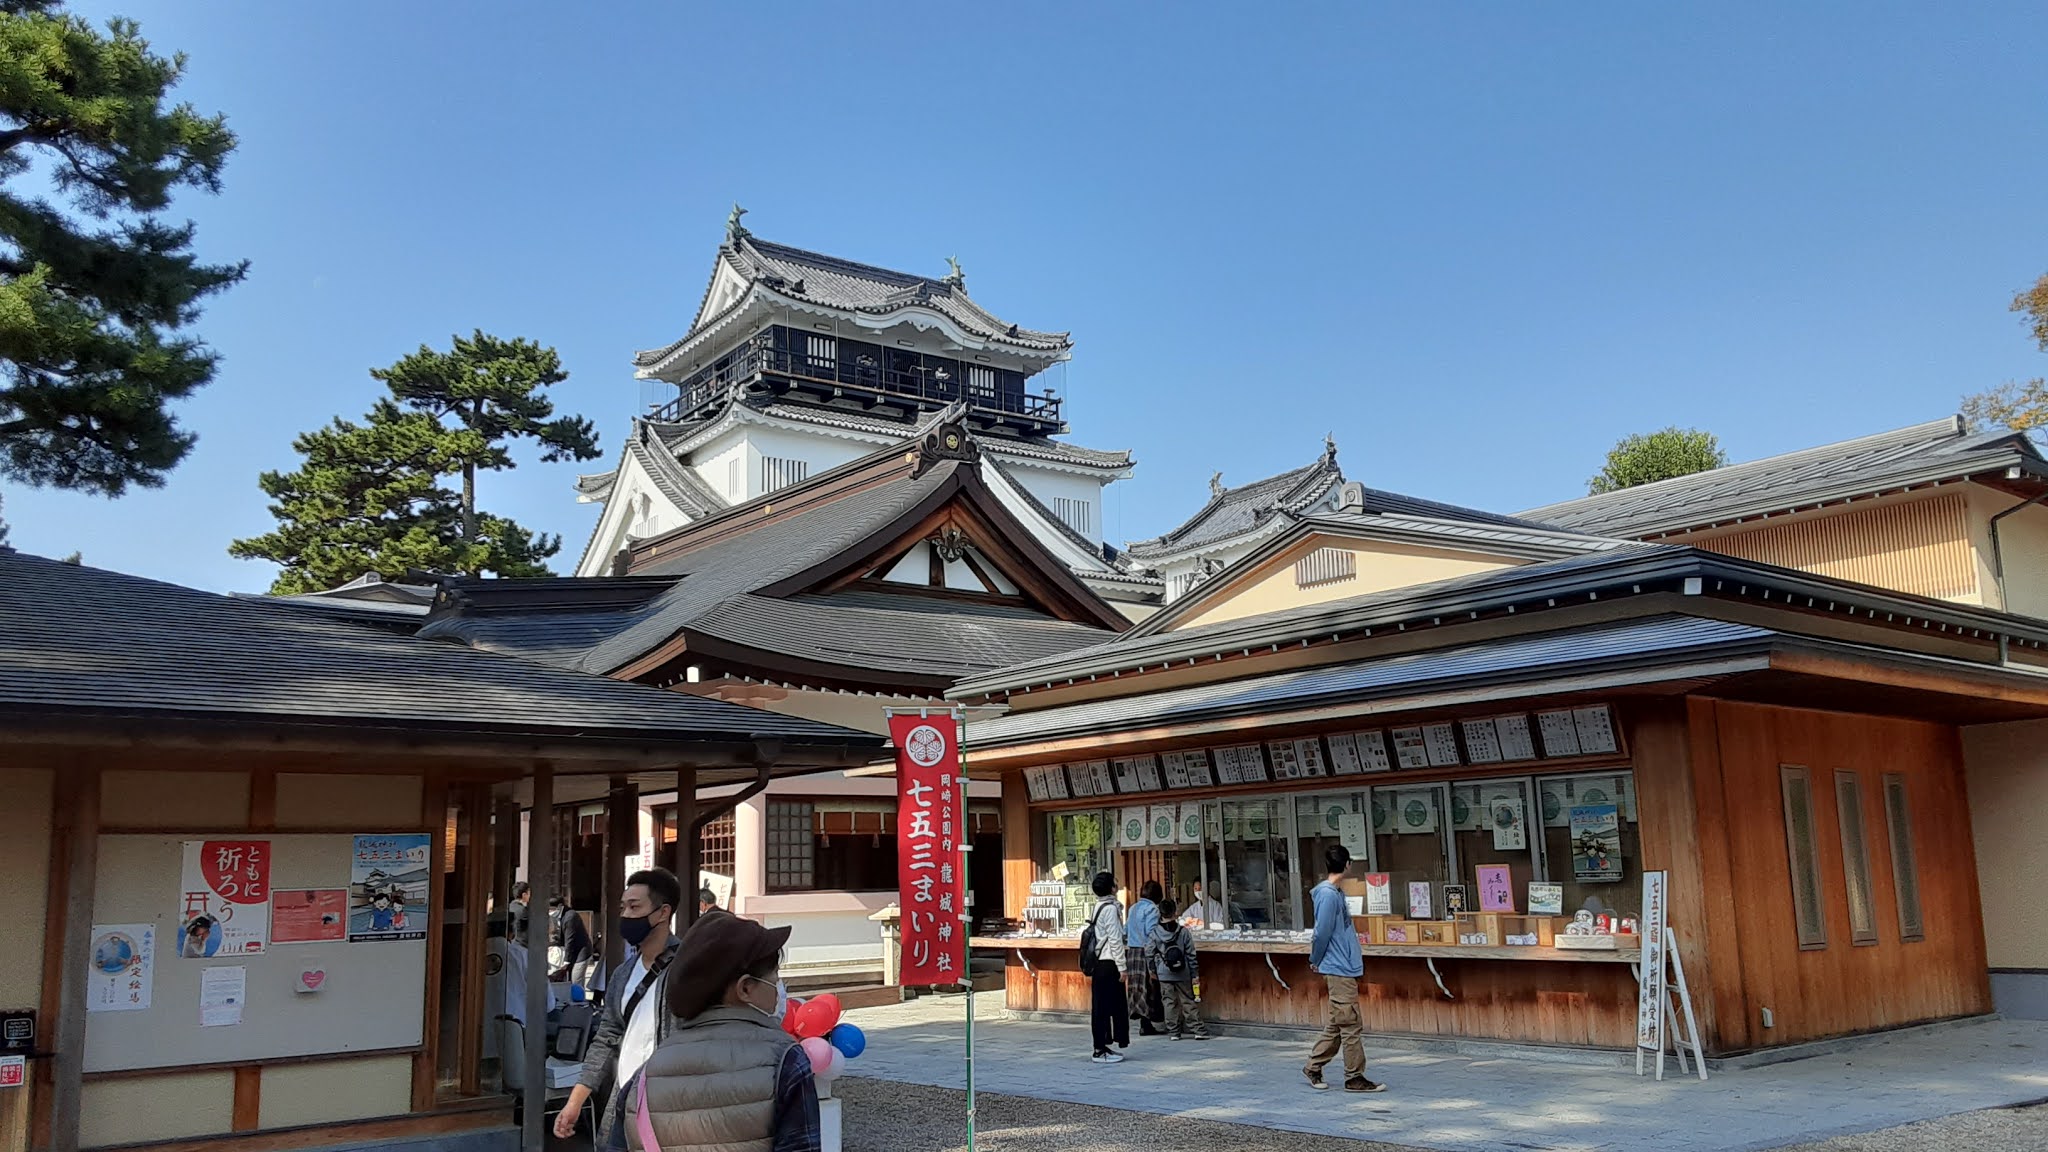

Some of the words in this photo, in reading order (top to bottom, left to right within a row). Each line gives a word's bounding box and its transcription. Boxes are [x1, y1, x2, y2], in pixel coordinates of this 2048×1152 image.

[216, 847, 243, 924] 祈ろう
[244, 846, 261, 897] ともに
[357, 849, 424, 860] 七五三まいり
[906, 778, 937, 967] 七五三まいり
[937, 862, 953, 972] 龍城神社
[129, 954, 143, 1003] 限定絵馬
